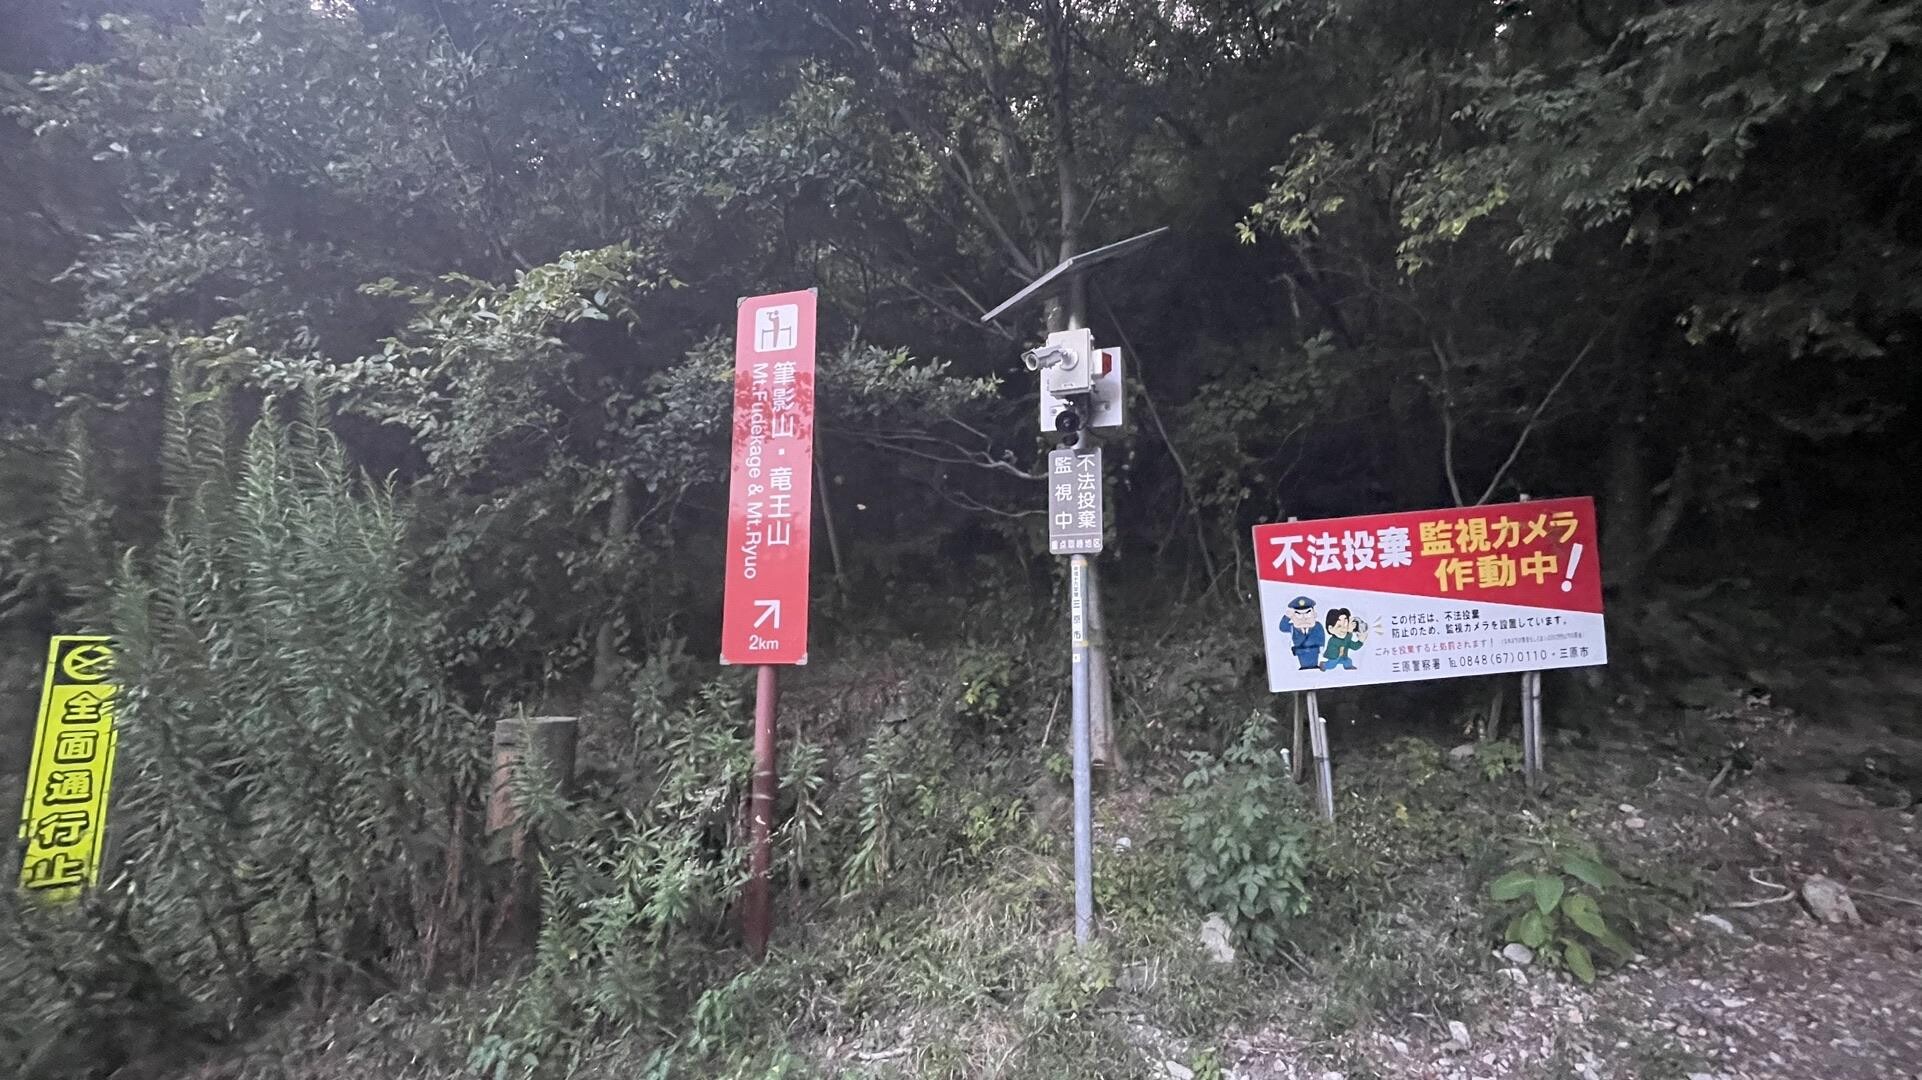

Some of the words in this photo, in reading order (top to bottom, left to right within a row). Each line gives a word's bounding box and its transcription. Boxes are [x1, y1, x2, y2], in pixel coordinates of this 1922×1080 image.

[746, 362, 769, 478] Mt.Fudekage
[767, 361, 797, 546] 筆影山・竜王山
[747, 483, 764, 496] &
[1054, 457, 1073, 530] 監視中
[1076, 454, 1097, 529] 不法投棄
[741, 502, 764, 580] Mt.Ryuo
[1269, 526, 1413, 577] 不法投棄
[1419, 511, 1579, 556] 監視カメラ
[748, 635, 779, 650] 2km
[25, 690, 102, 890] 全面通行止
